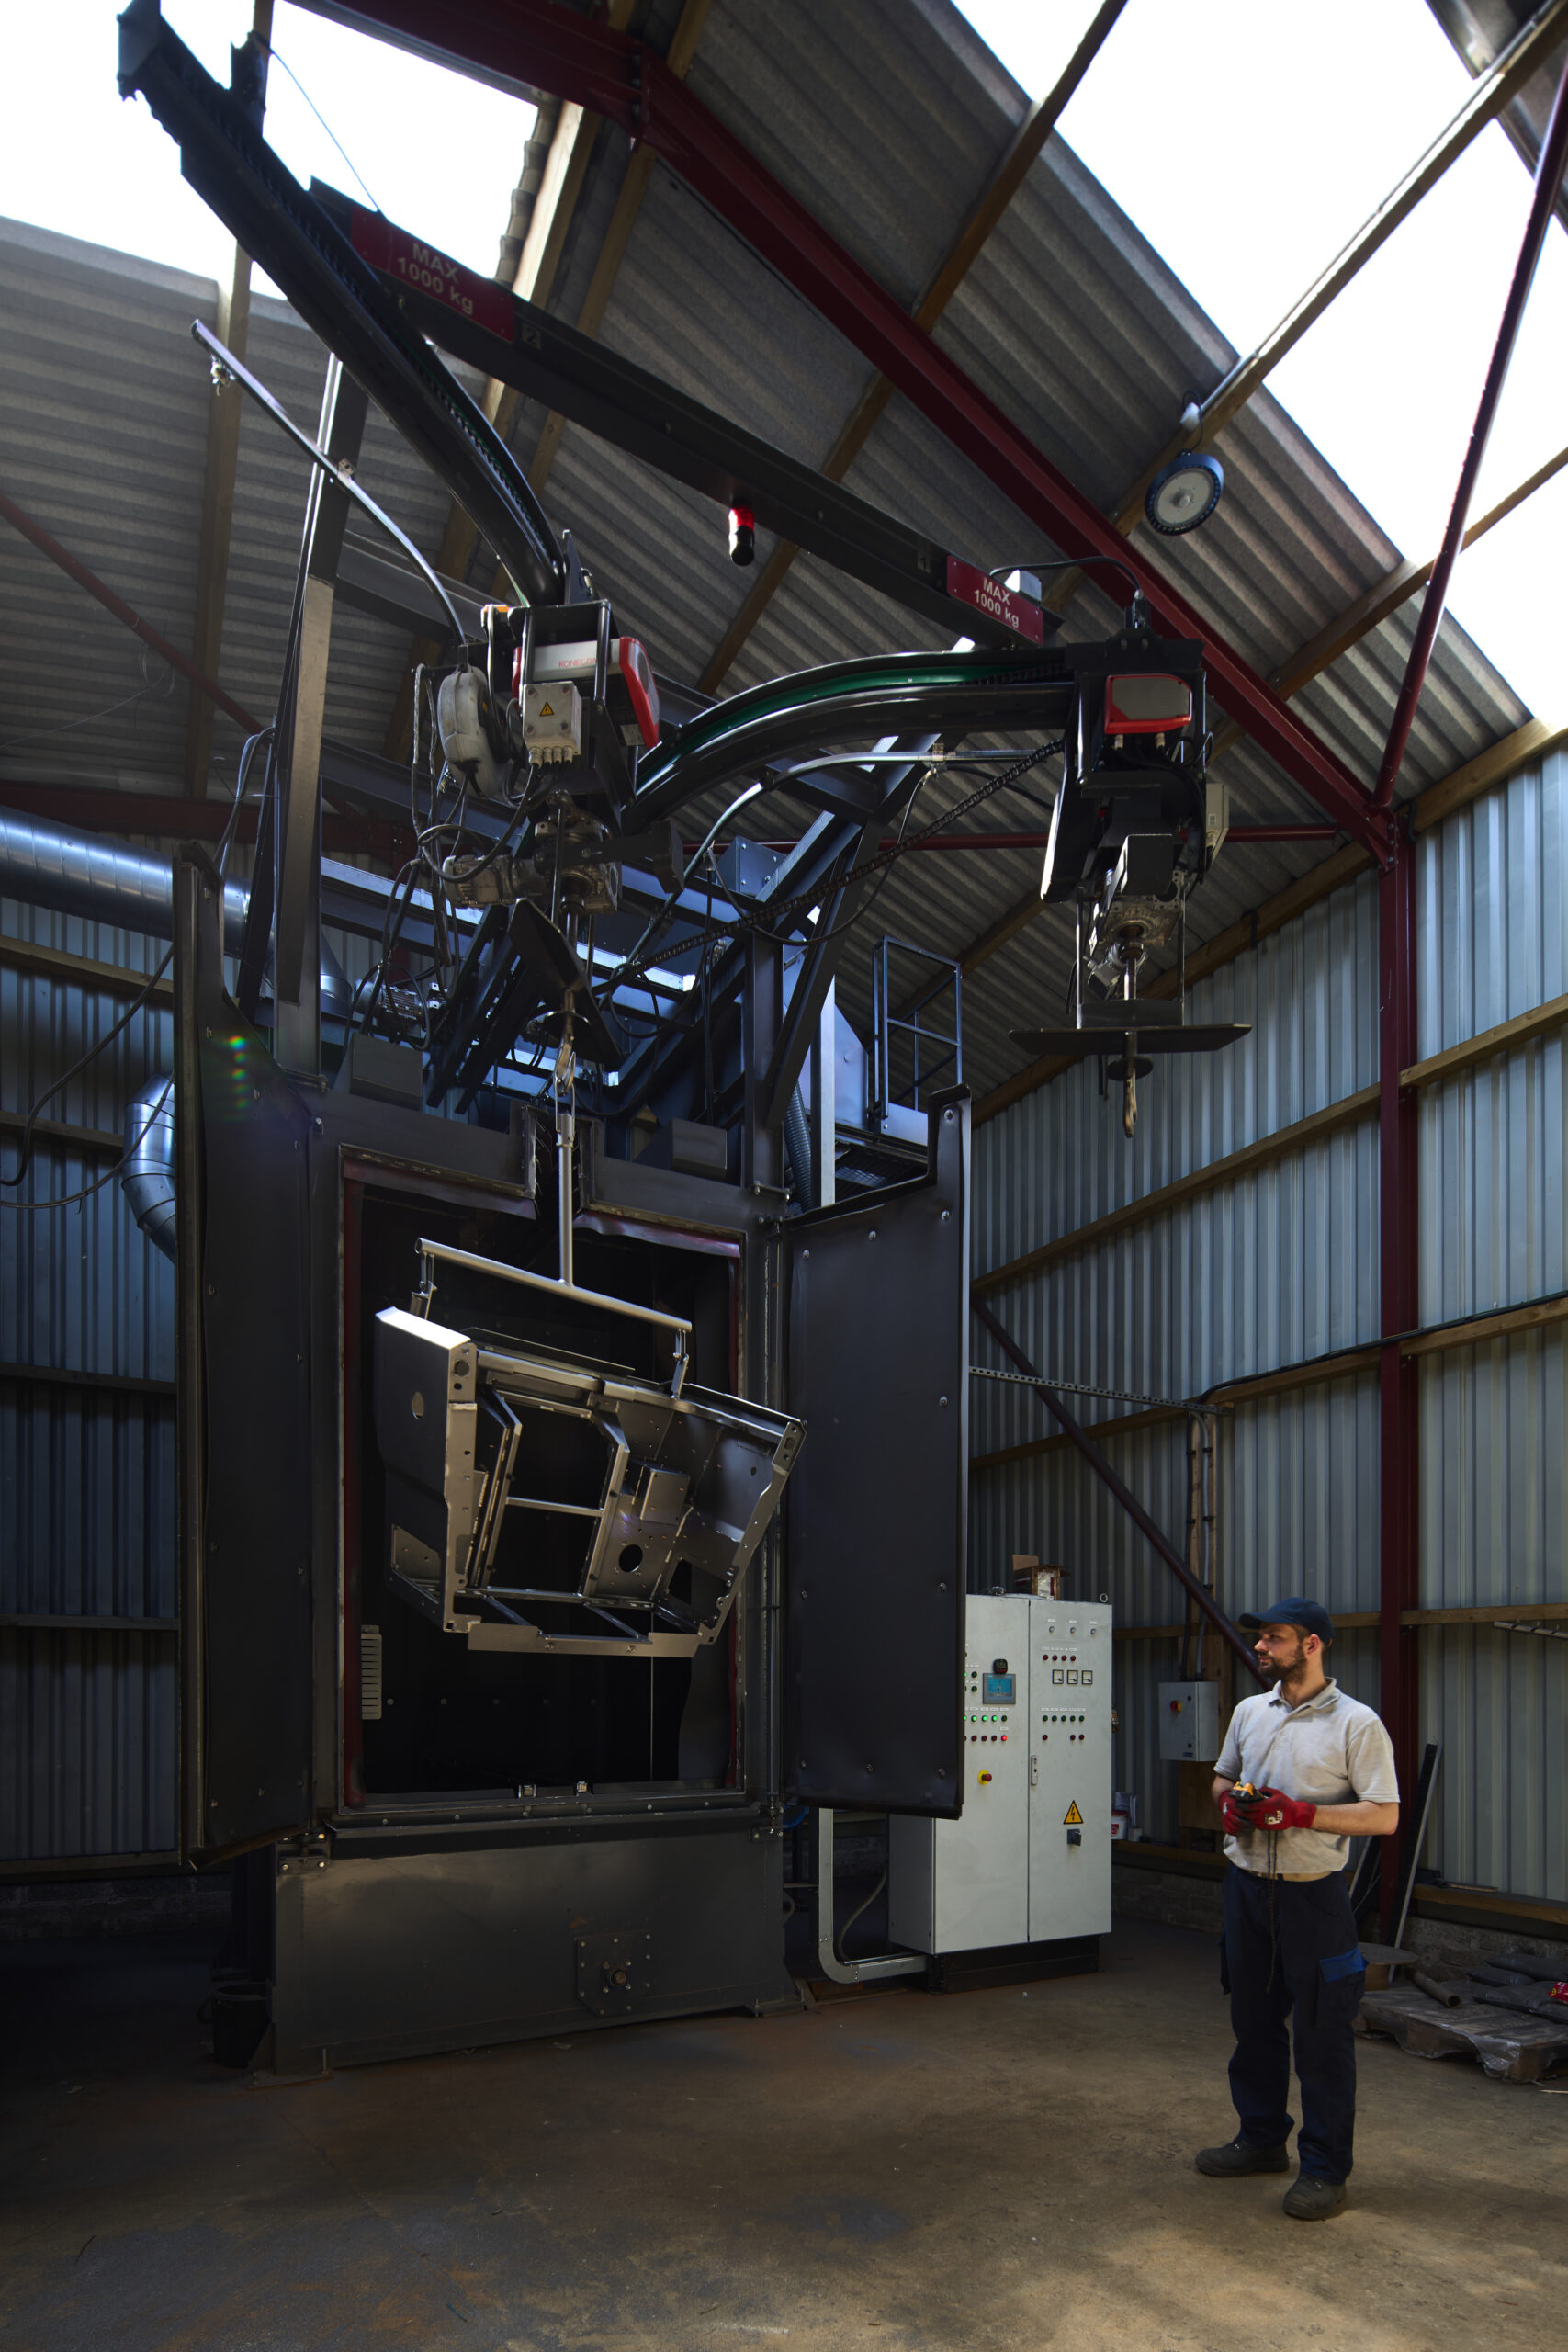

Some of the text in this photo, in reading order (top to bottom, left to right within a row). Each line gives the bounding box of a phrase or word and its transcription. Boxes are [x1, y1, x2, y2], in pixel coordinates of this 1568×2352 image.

[412, 243, 459, 285] MAX
[397, 257, 474, 315] 1000 kg
[974, 589, 1020, 628] 1000 kg
[983, 577, 1010, 605] MAX
[558, 657, 597, 669] KONECRA
